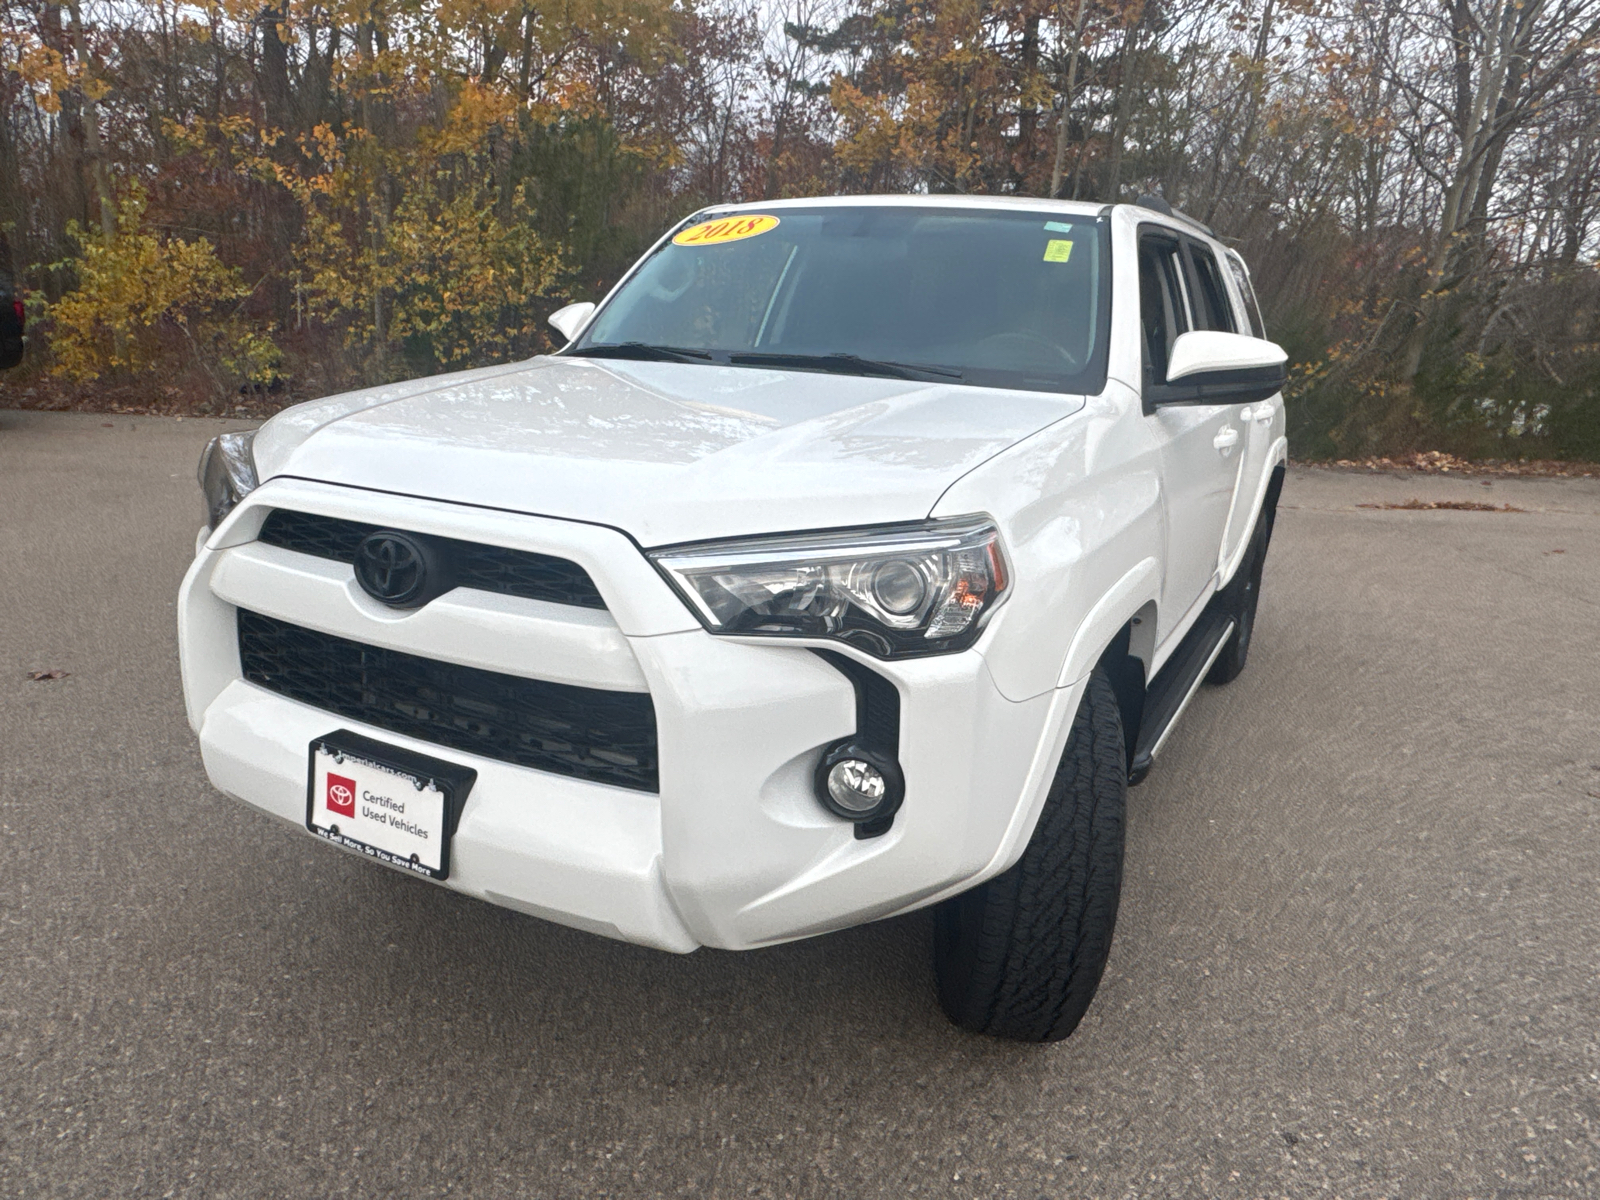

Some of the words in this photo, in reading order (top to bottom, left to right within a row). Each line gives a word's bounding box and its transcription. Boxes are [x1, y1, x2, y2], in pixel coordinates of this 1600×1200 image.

[685, 218, 764, 243] 2018
[362, 790, 405, 814] Certified
[362, 806, 387, 824] Used
[388, 815, 429, 839] Vehicles
[316, 827, 329, 838] We
[329, 831, 343, 844] Sell
[343, 837, 364, 853] More,
[365, 845, 375, 856] So
[376, 850, 391, 861] You
[391, 855, 410, 868] Save
[411, 863, 431, 876] More
